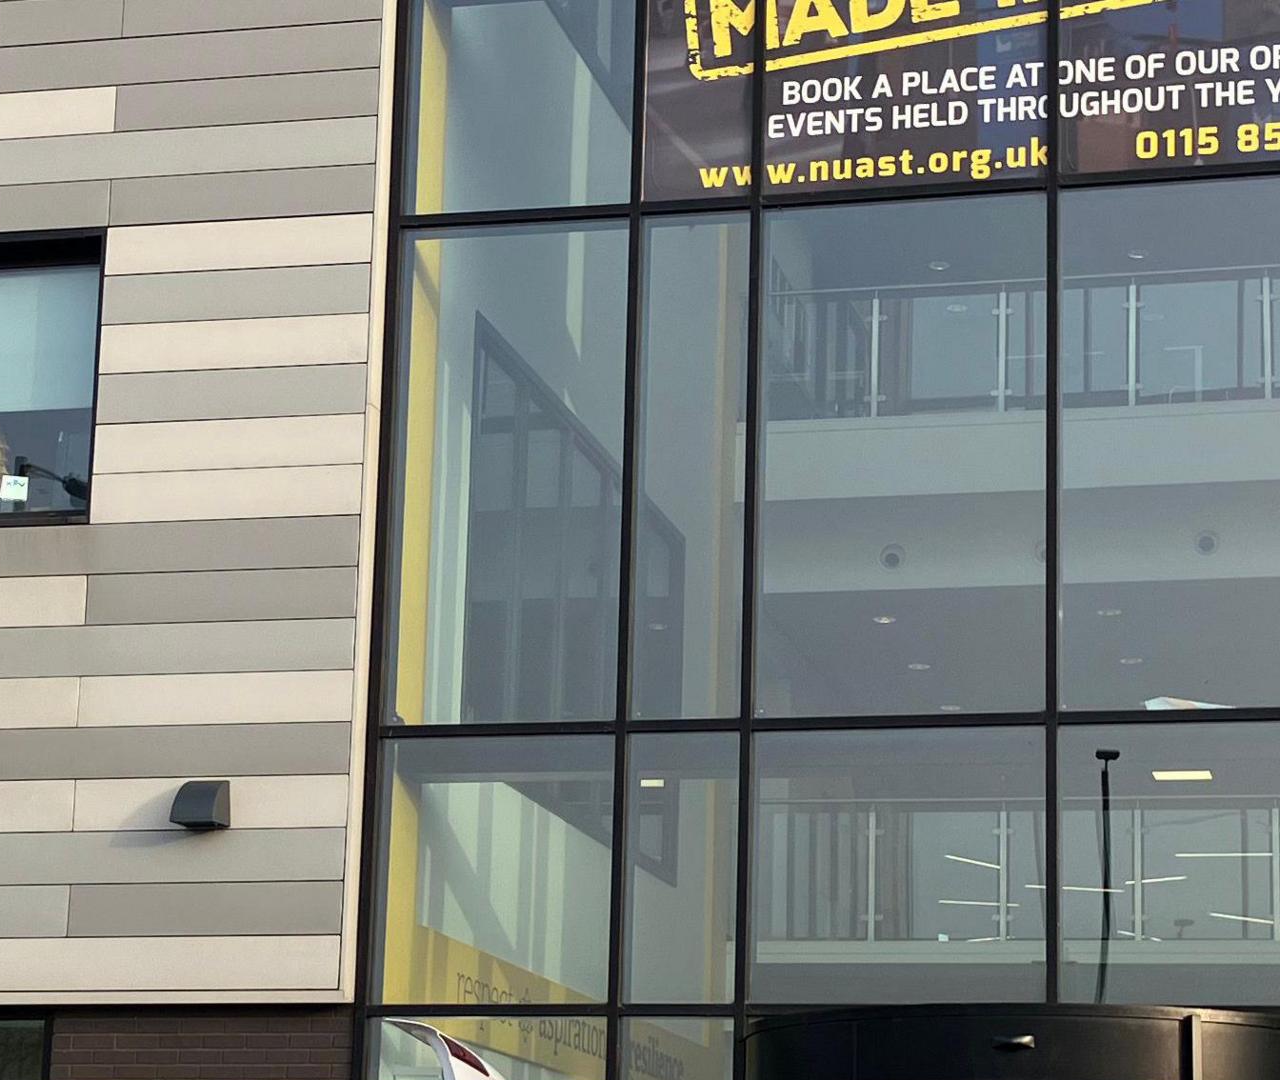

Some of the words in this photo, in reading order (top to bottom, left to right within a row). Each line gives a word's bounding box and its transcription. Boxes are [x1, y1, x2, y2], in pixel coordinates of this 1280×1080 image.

[782, 76, 863, 105] BOOK
[872, 73, 894, 98] A
[902, 66, 997, 96] PLACE
[1006, 62, 1044, 88] AT
[1058, 56, 1115, 85] ONE
[1124, 53, 1166, 80] OF
[1175, 47, 1240, 76] OUR
[768, 107, 883, 138] EVENTS
[892, 100, 969, 130] HELD
[1194, 79, 1256, 107] THE
[699, 137, 1048, 188] www.nuast.org.uk
[1135, 126, 1220, 159] 0115
[538, 1016, 607, 1060] aspiration
